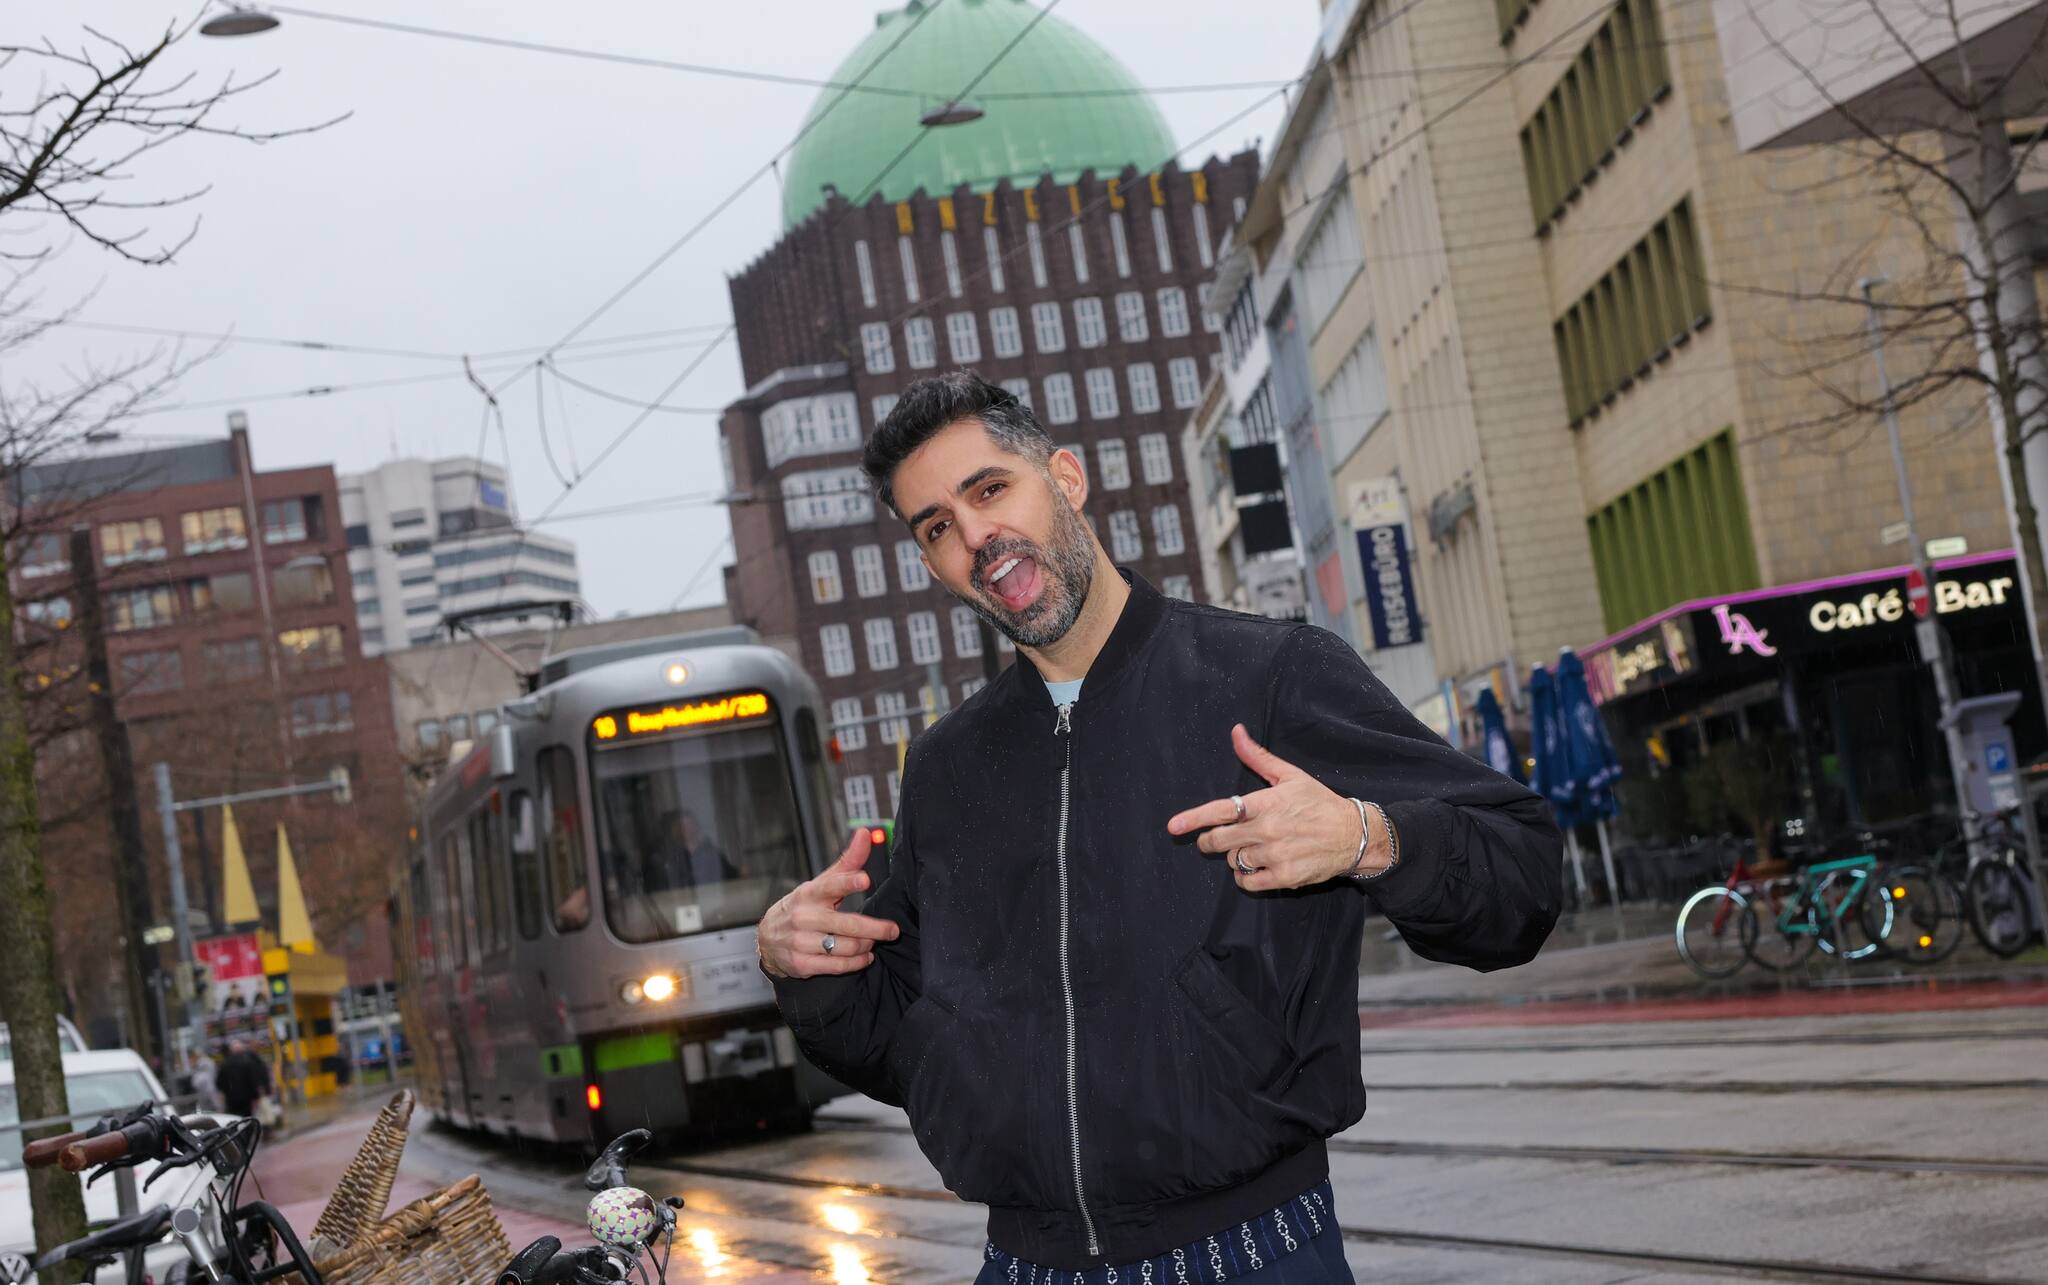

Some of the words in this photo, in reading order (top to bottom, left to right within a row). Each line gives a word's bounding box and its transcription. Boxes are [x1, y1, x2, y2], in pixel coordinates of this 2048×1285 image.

[1371, 526, 1412, 644] REISEBÜRO
[1809, 588, 1904, 632] Café
[1934, 577, 2012, 614] Bar
